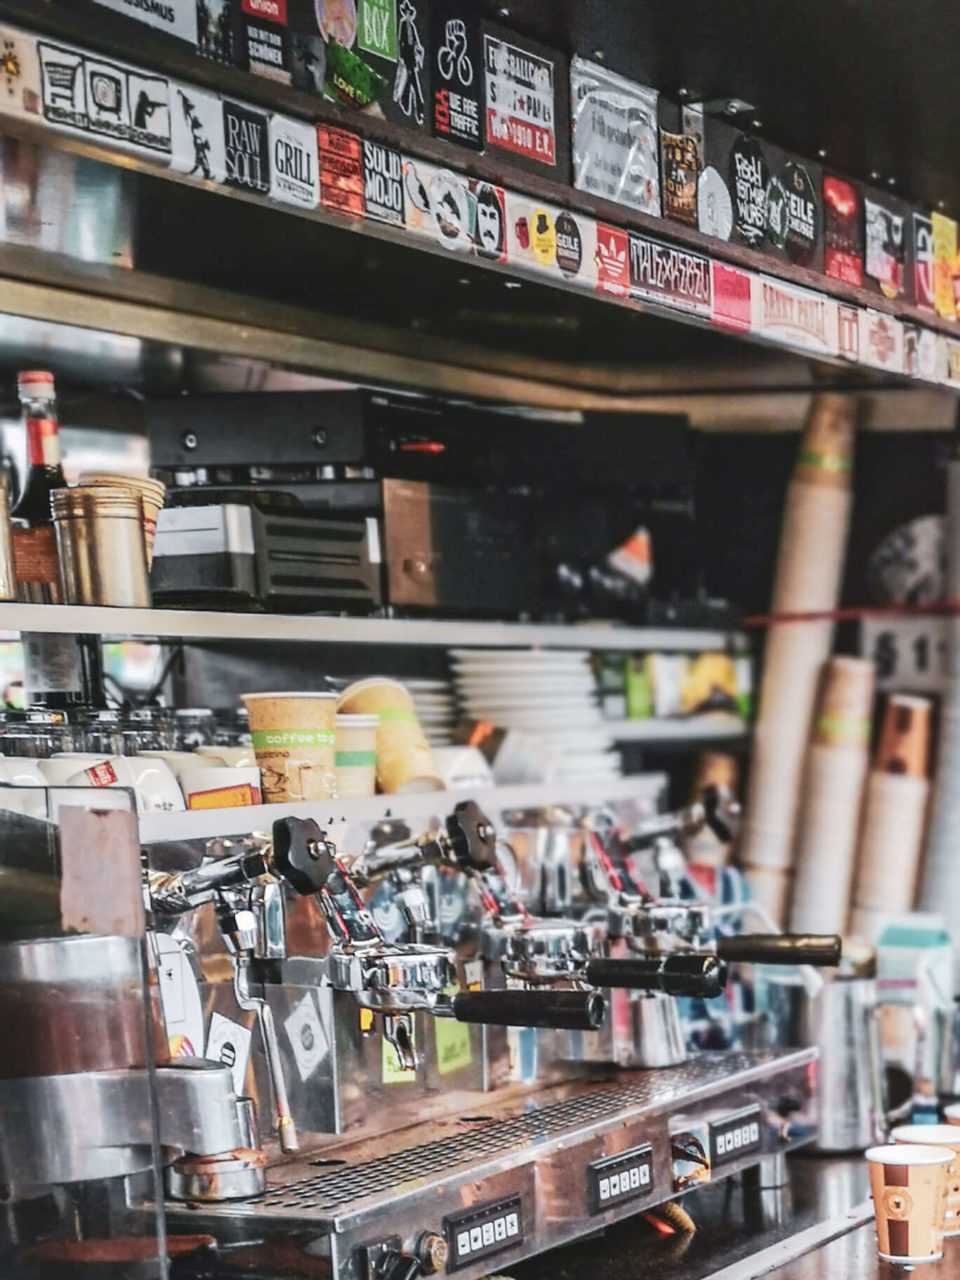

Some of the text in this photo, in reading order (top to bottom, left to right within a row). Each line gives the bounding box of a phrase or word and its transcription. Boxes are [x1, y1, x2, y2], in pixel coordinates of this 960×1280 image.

[364, 1, 390, 52] BOX
[227, 114, 261, 155] RAW
[225, 147, 270, 191] SOUL
[275, 139, 315, 187] GRILL
[364, 141, 402, 180] SOLID
[365, 168, 402, 211] MOJO
[265, 733, 314, 744] coffee
